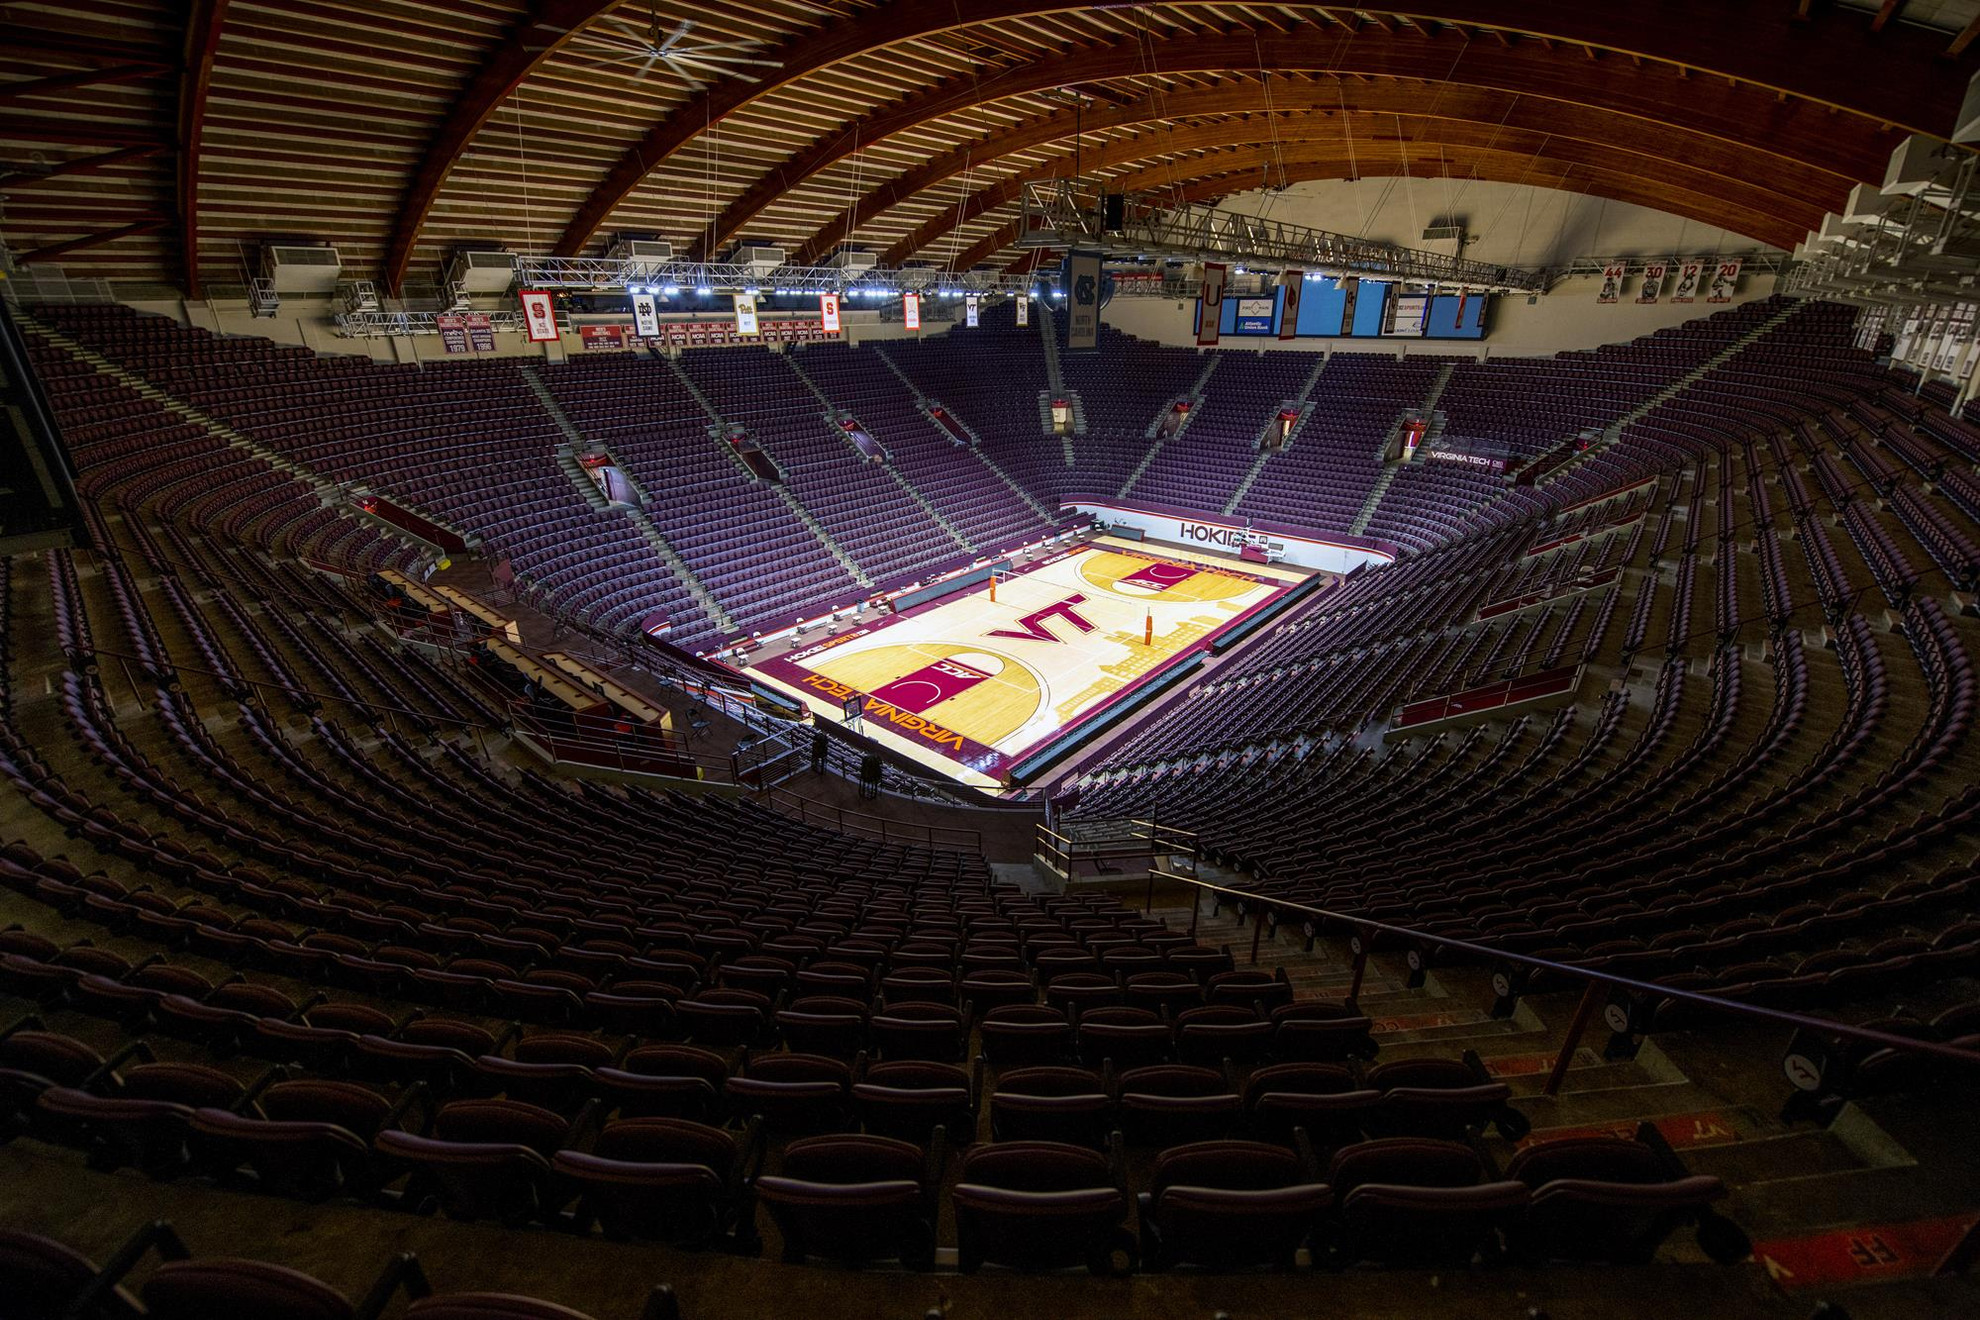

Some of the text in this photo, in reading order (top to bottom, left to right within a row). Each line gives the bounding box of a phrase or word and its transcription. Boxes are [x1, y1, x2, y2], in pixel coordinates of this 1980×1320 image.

[1605, 267, 1621, 278] 44
[1646, 267, 1662, 278] 30
[1684, 266, 1698, 277] 12
[1720, 265, 1737, 276] 20
[1431, 451, 1469, 463] VIRGINIA
[1468, 456, 1491, 466] TECH
[986, 593, 1096, 643] VT
[931, 662, 982, 680] ACC
[863, 697, 965, 751] VIRGINIA
